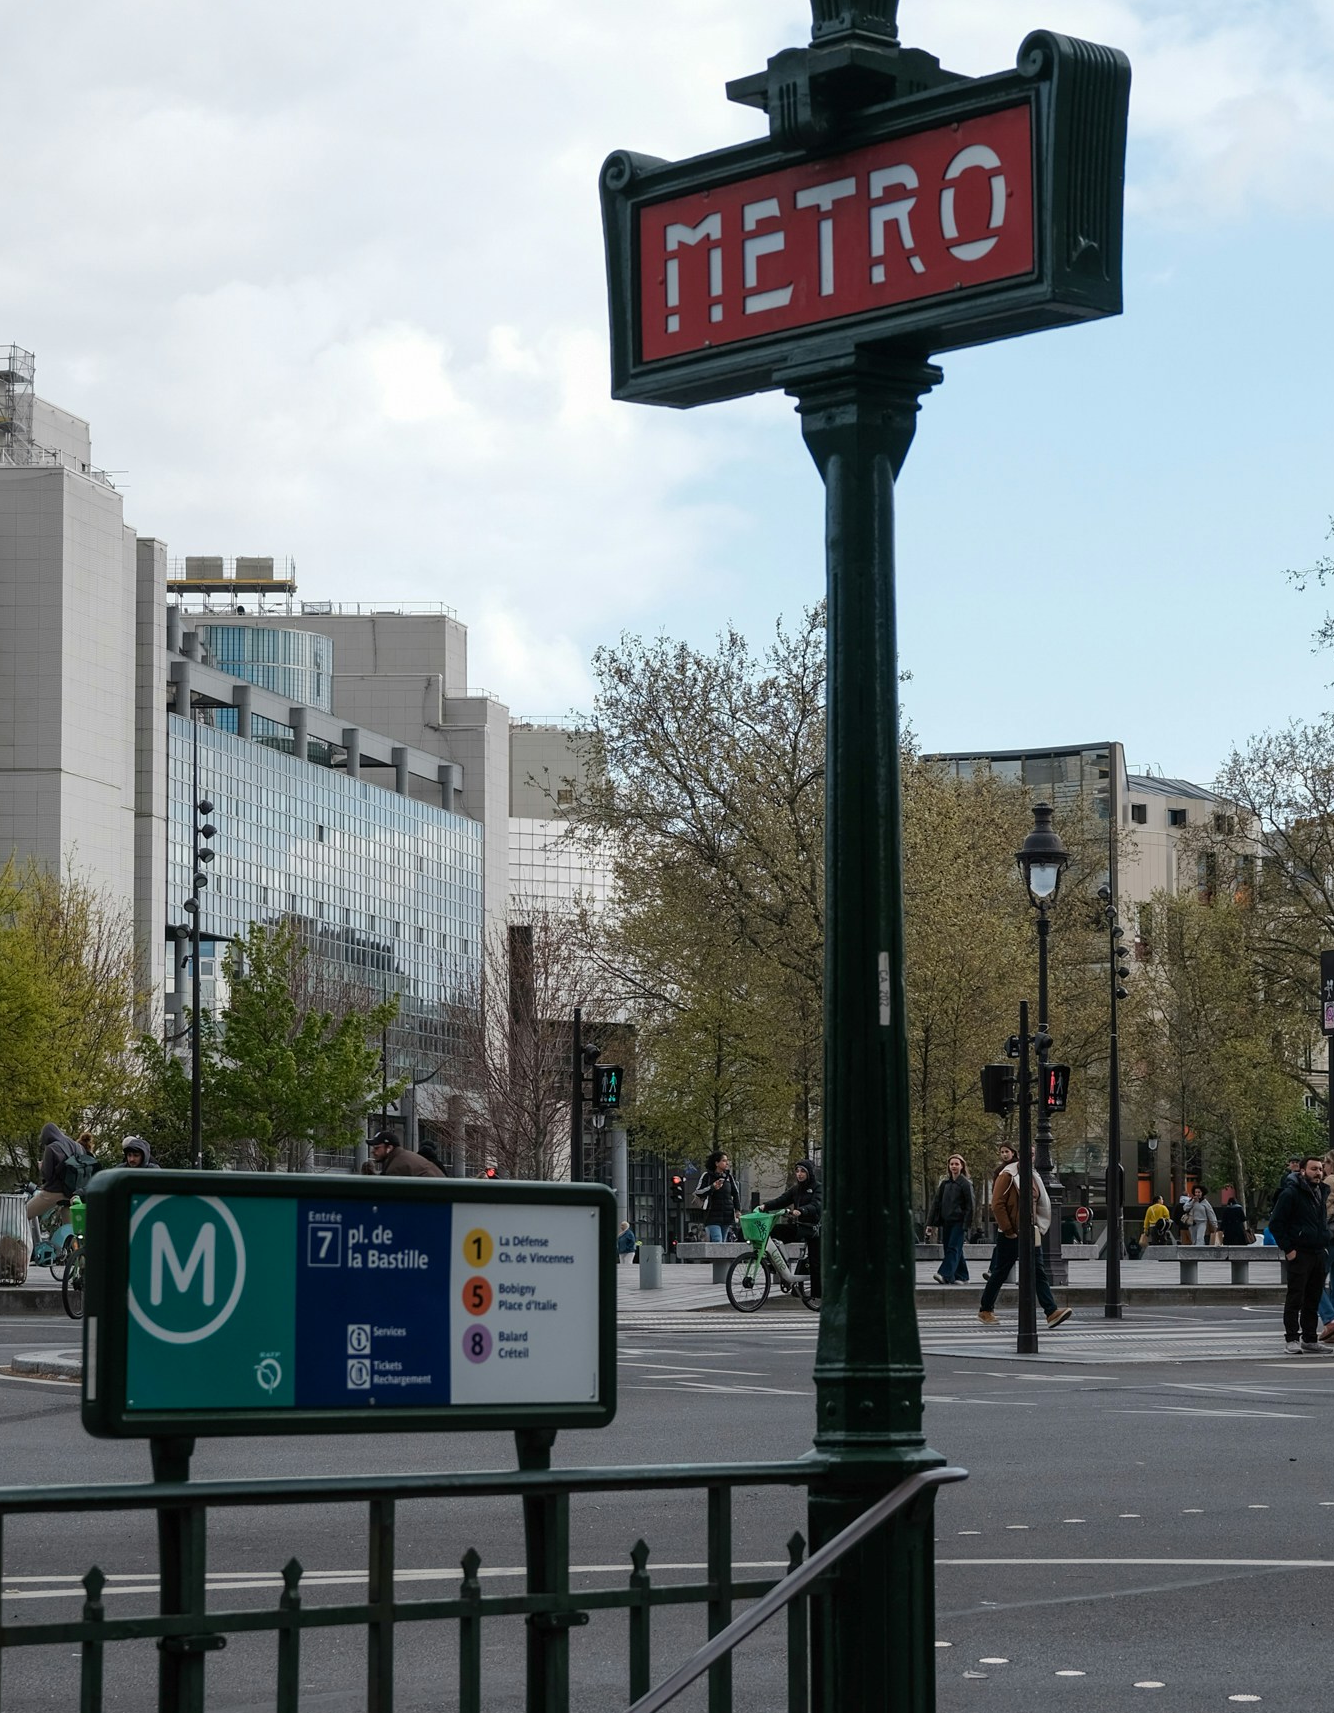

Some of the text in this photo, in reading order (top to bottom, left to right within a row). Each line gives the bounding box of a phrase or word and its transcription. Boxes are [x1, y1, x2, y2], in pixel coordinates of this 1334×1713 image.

[665, 144, 1007, 335] METRO
[308, 1211, 342, 1222] Entrée
[348, 1225, 393, 1247] pl. de
[500, 1236, 549, 1247] La Défense
[317, 1231, 333, 1258] 7
[472, 1237, 481, 1260] 1
[150, 1221, 216, 1306] M
[348, 1249, 428, 1268] la Bastille
[499, 1253, 574, 1264] Ch. de Vincennes
[499, 1284, 536, 1296] Bobigny
[472, 1285, 483, 1308] 5
[499, 1300, 557, 1310] Place d'Italie
[373, 1326, 406, 1336] Services
[499, 1332, 528, 1341] Balard
[471, 1333, 483, 1356] 8
[499, 1348, 529, 1358] Créteil
[373, 1361, 402, 1370] Tickets
[373, 1375, 431, 1386] Rechargement
